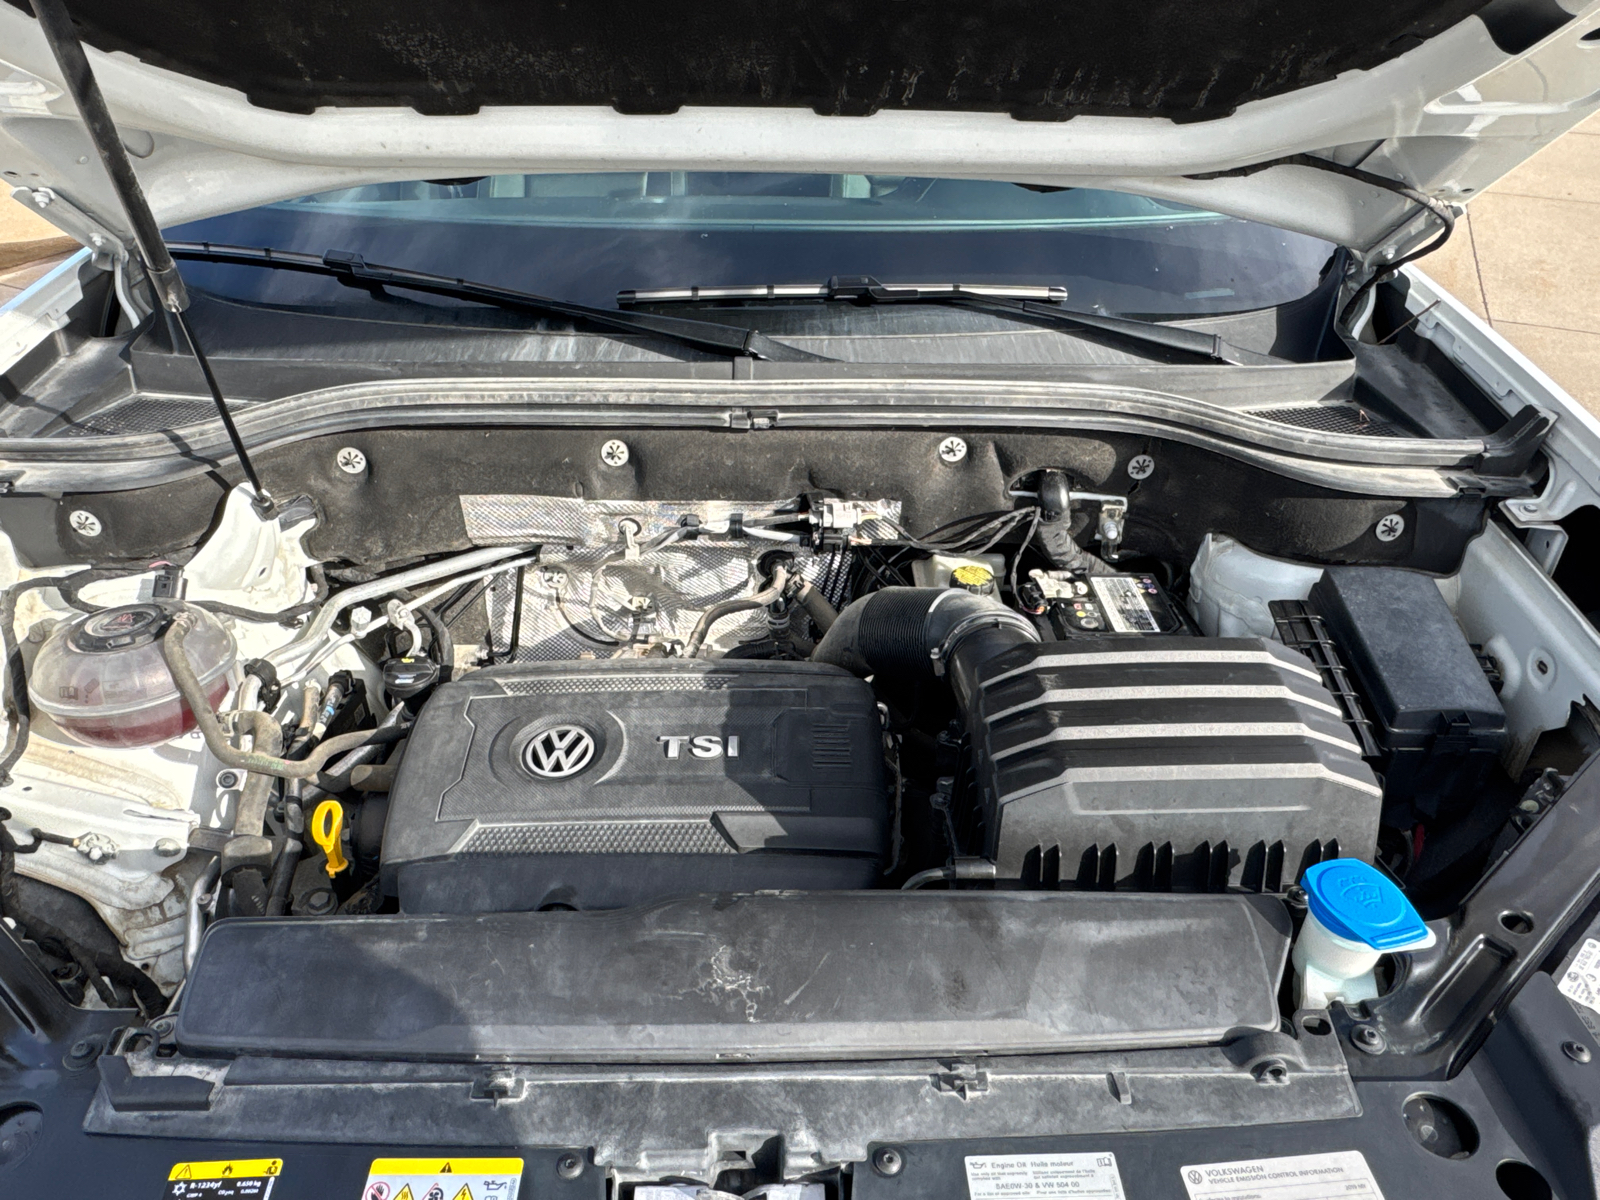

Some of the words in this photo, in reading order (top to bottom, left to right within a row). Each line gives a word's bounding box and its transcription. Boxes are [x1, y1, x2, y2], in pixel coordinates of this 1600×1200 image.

[657, 735, 740, 760] TSI
[991, 1162, 1015, 1170] Engine
[1205, 1165, 1264, 1177] VOLKSWAGEN
[1208, 1176, 1235, 1185] VEHICLE
[1236, 1173, 1267, 1183] EMISSION
[1267, 1170, 1298, 1180] CONTROL
[1299, 1166, 1344, 1177] INFORMATION
[189, 1181, 223, 1190] R-1234yf
